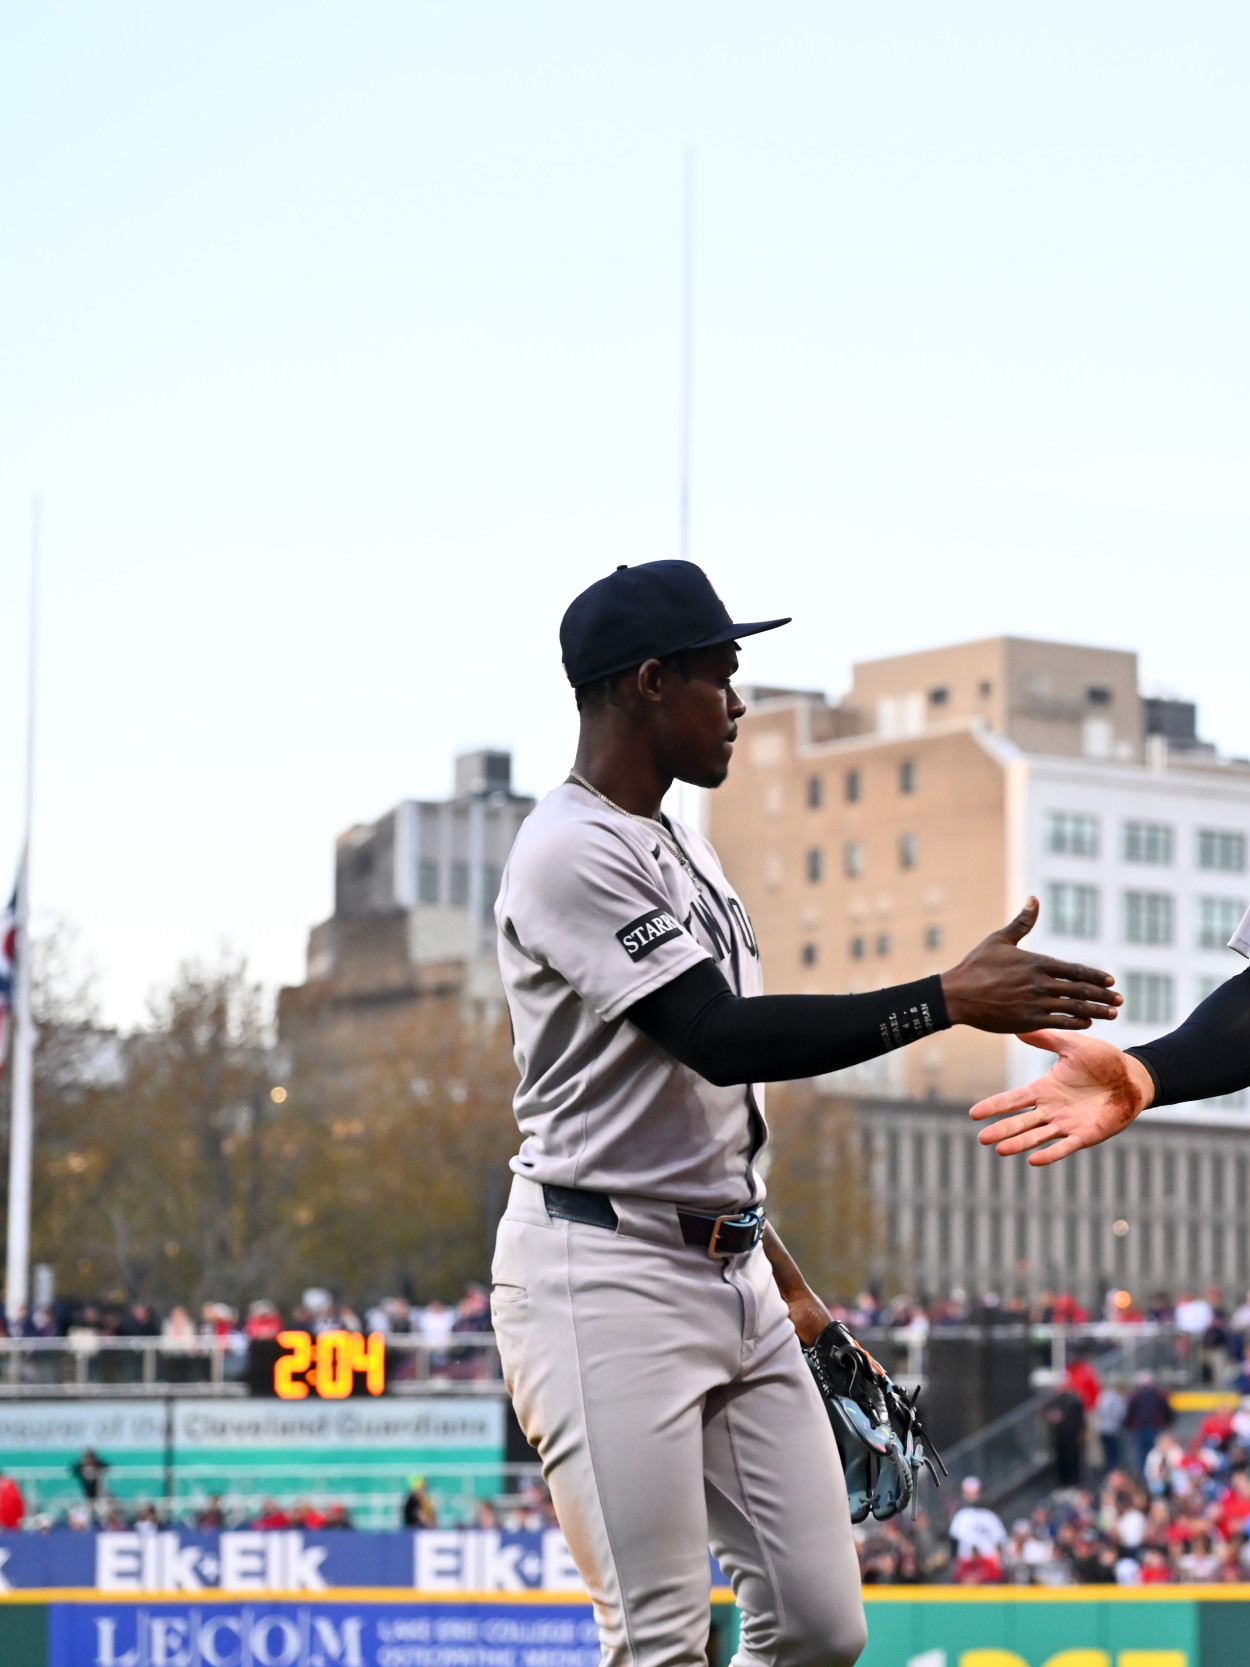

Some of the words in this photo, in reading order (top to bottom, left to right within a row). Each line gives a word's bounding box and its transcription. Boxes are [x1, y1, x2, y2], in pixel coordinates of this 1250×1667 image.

[274, 1330, 386, 1399] 2:04
[183, 1410, 327, 1438] Cleveland
[336, 1410, 488, 1438] Guardians
[94, 1610, 365, 1667] LECOM
